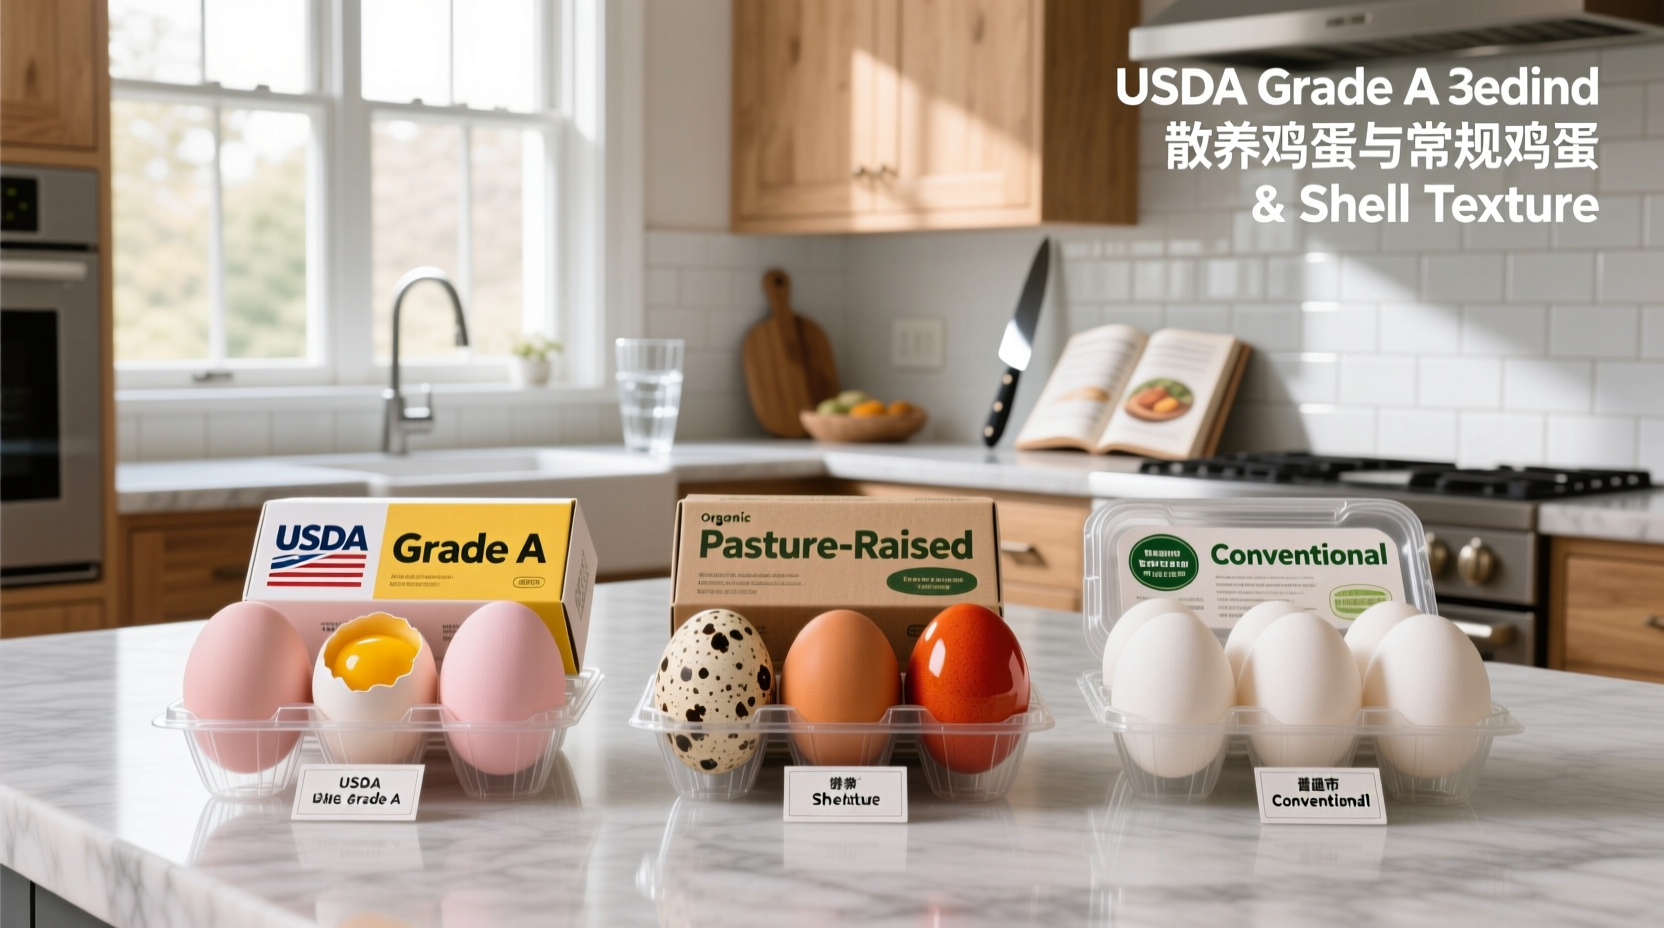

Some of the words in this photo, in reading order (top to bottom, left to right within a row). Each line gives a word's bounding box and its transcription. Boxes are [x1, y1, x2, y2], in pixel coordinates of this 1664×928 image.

[701, 511, 751, 527] Organic
[275, 524, 369, 551] USDA
[699, 529, 973, 560] Pasture-Raised
[392, 532, 509, 564] Grade
[515, 533, 547, 564] A
[1211, 542, 1388, 566] Conventional
[339, 776, 381, 789] USDA
[390, 793, 401, 805] A
[1272, 793, 1371, 808] Conventional
